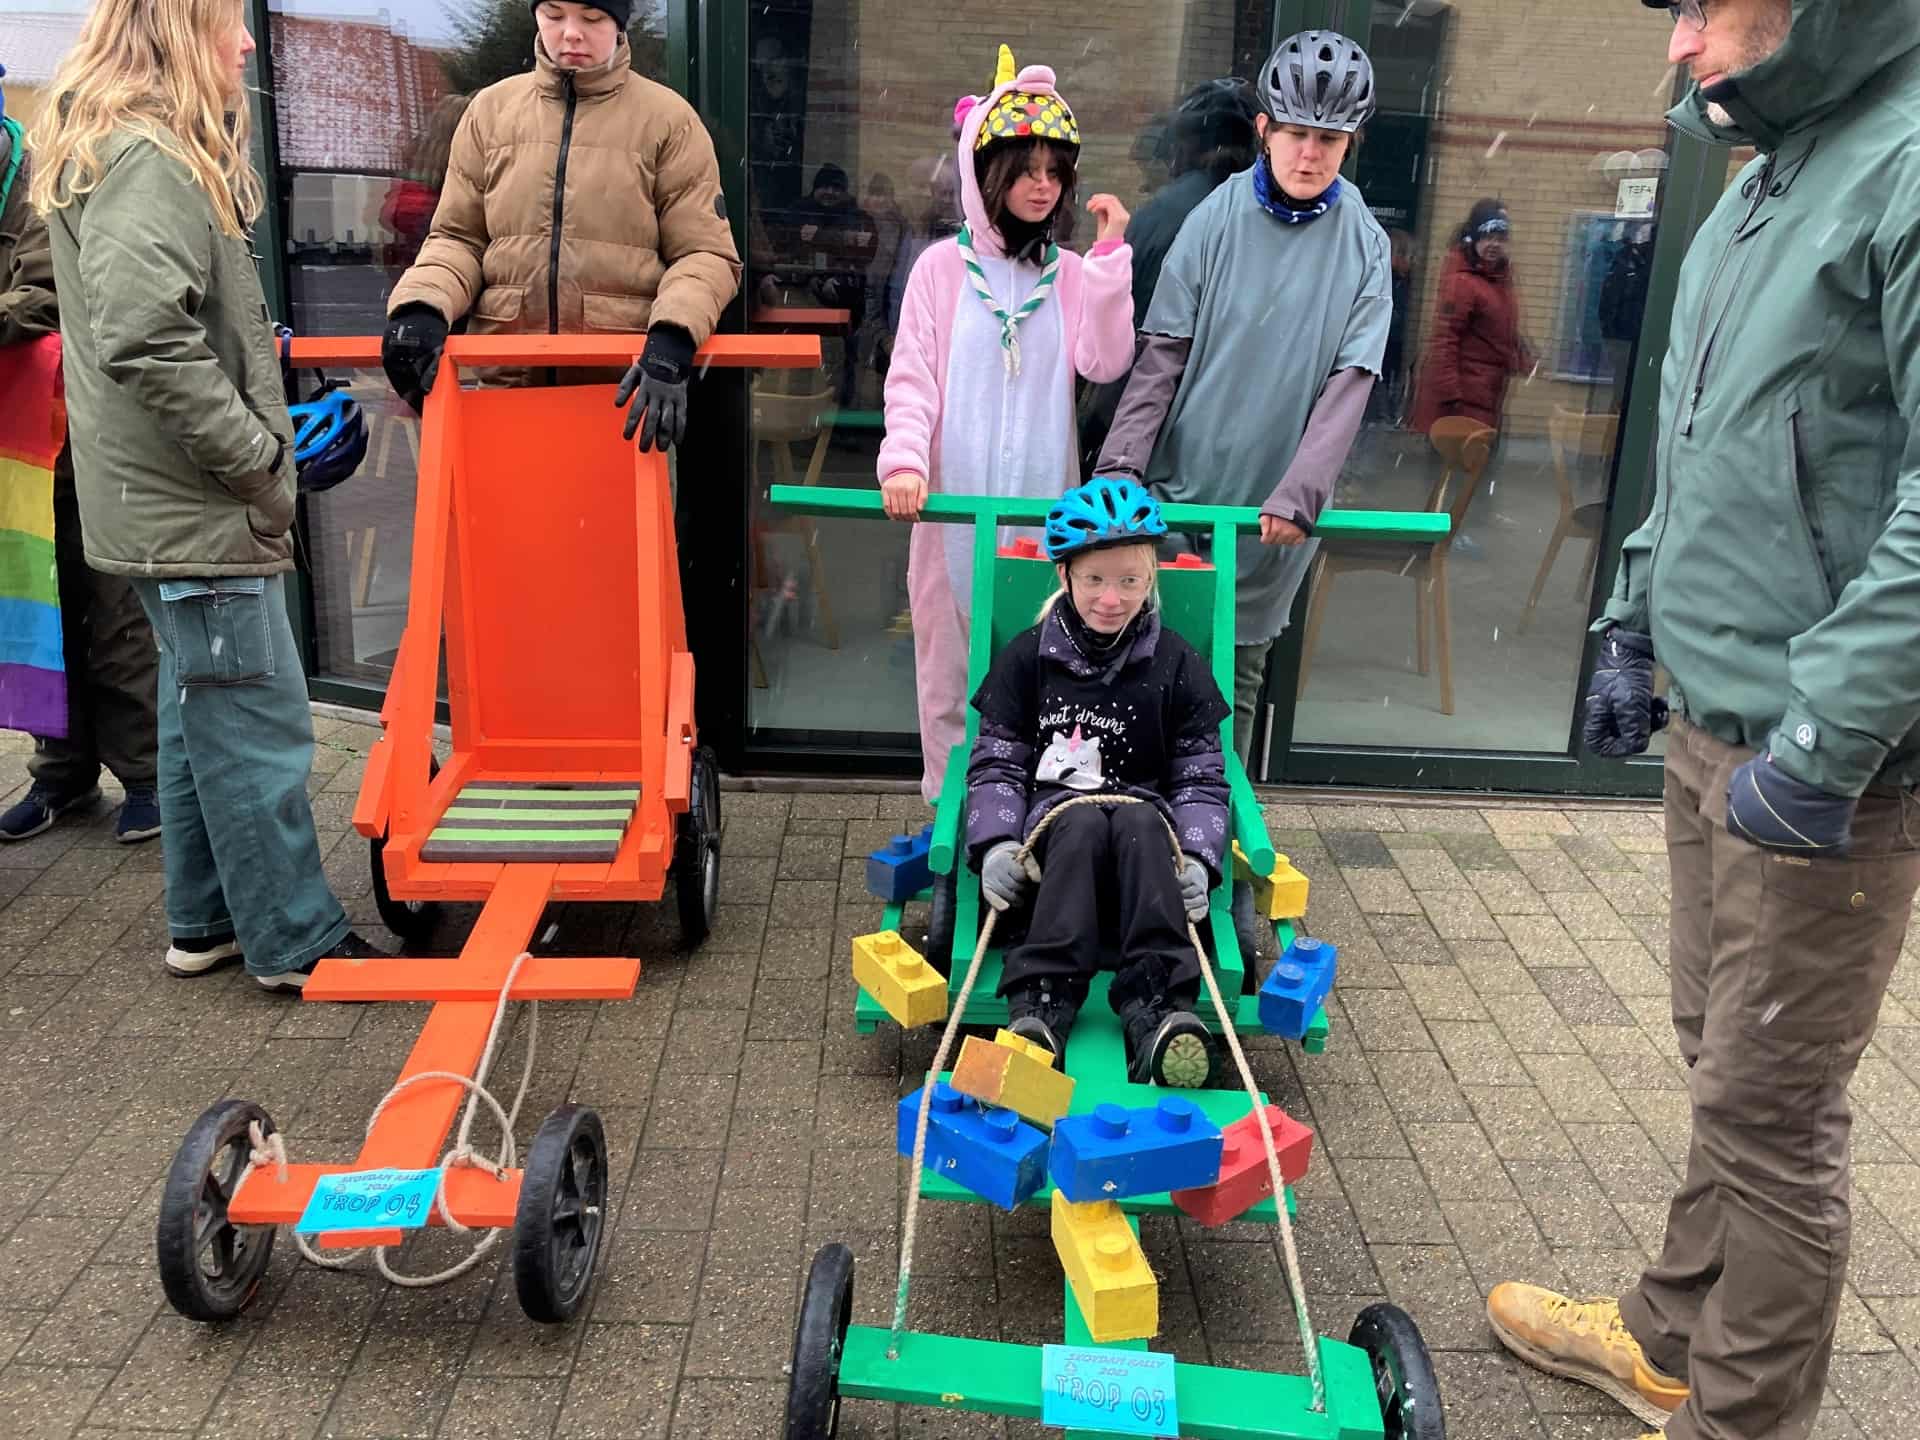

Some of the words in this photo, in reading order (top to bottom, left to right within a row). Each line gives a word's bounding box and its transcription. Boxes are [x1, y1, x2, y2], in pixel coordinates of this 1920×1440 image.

[1039, 703, 1071, 730] sweet
[1075, 708, 1126, 735] dreams
[323, 1194, 381, 1213] TROP
[385, 1192, 421, 1219] 04
[1056, 1374, 1120, 1412] TROP
[1132, 1386, 1165, 1426] 03
